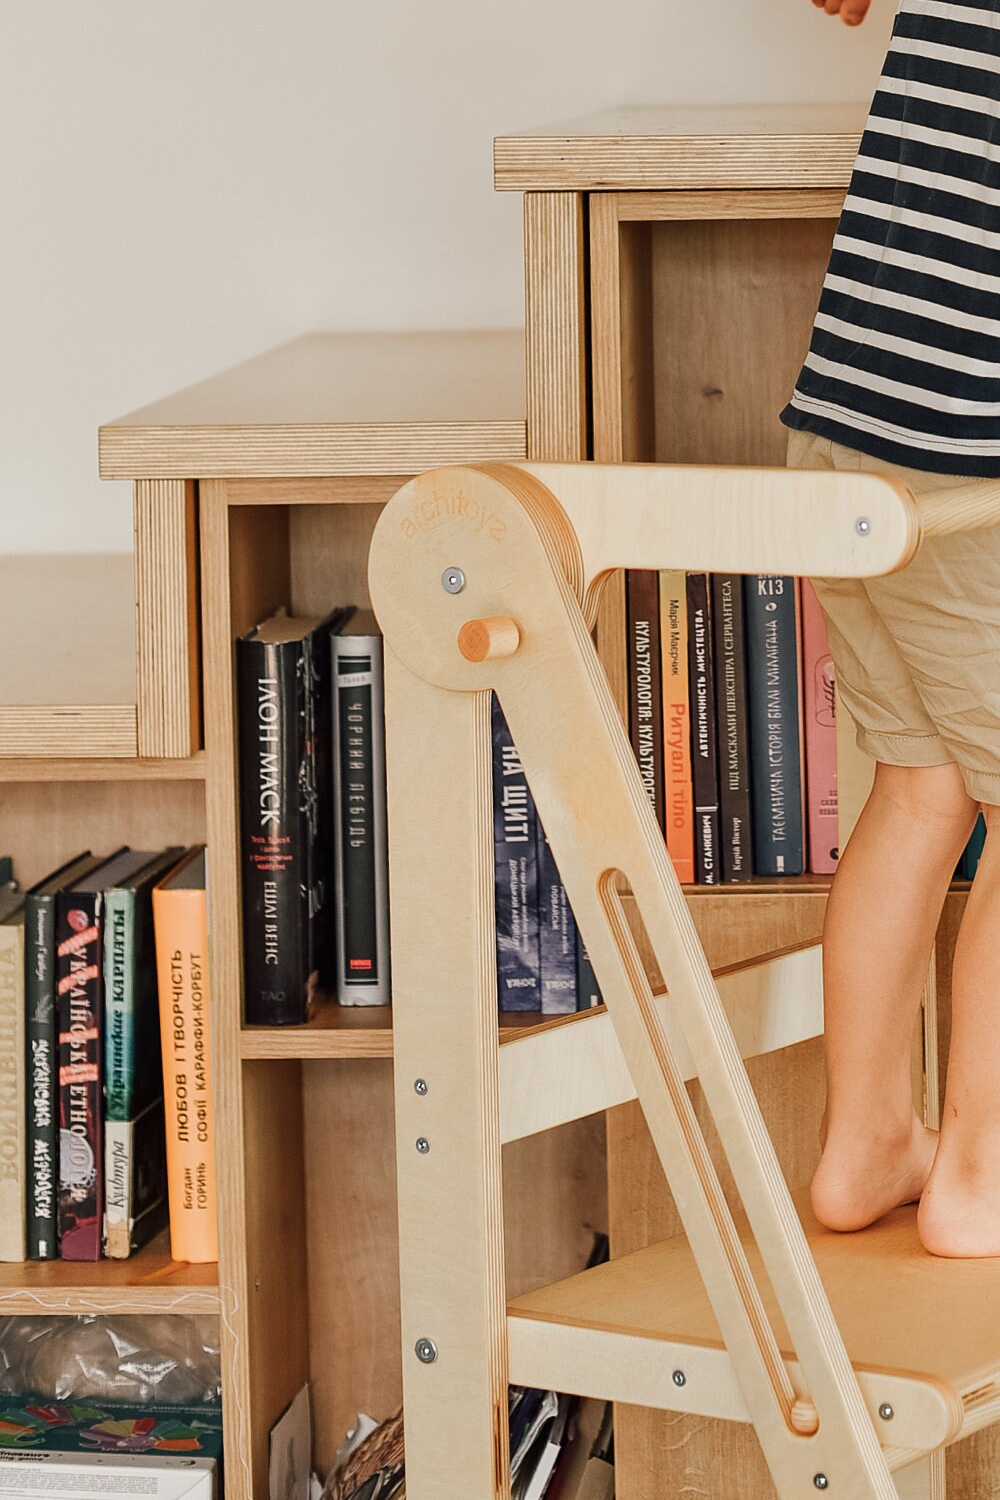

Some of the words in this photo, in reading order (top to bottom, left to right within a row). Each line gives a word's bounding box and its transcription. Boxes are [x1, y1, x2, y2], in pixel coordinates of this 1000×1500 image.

[670, 599, 683, 630] Марія
[695, 609, 706, 673] МИСТЕЦТВА
[722, 580, 735, 650] СЕРВАНТЕСА
[634, 621, 656, 722] КУЛЬТУРОЛОГІЯ:
[764, 620, 781, 685] МІЛЛІГАНА
[256, 678, 281, 743] ІЛОН
[670, 702, 687, 774] Ритуал
[697, 676, 709, 758] АВТЕНТИЧНІСТЬ
[726, 714, 740, 770] МАСКАМИ
[767, 722, 784, 767] ІСТОРІЯ
[256, 751, 283, 827] МАСК
[501, 784, 530, 844] ЩИТІ
[673, 789, 688, 830] тіло
[769, 770, 787, 843] ТАЄМНИЧА
[702, 815, 714, 870] СТАНКЕВИЧ
[108, 907, 127, 1003] КАРПАТЫ
[265, 924, 279, 965] ВЕНС
[171, 950, 187, 1053] ТВОРЧІСТЬ
[189, 953, 207, 1091] КАРАФФИ-КОРБУТ
[175, 1074, 190, 1143] ЛЮБОВ
[195, 1101, 208, 1143] СОФІЇ
[107, 1139, 131, 1209] Культура
